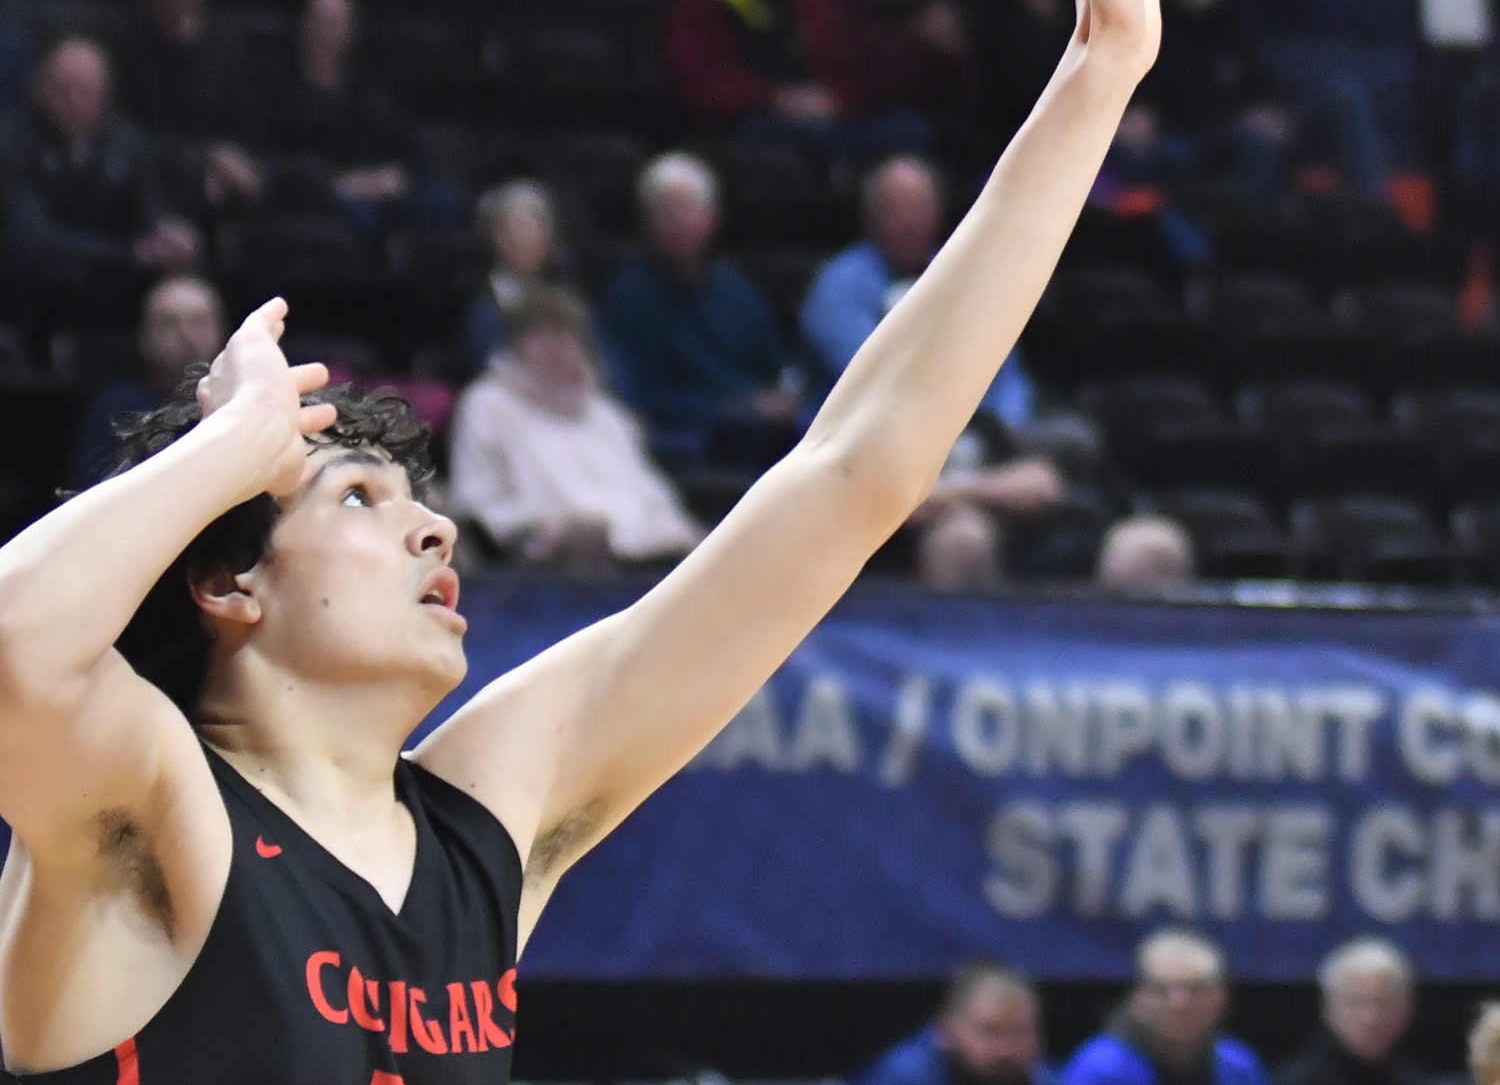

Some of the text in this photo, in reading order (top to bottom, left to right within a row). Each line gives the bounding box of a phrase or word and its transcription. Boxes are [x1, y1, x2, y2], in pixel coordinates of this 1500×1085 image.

[686, 673, 862, 774] AA
[948, 676, 1386, 784] ONPOINT
[984, 804, 1334, 919] STATE
